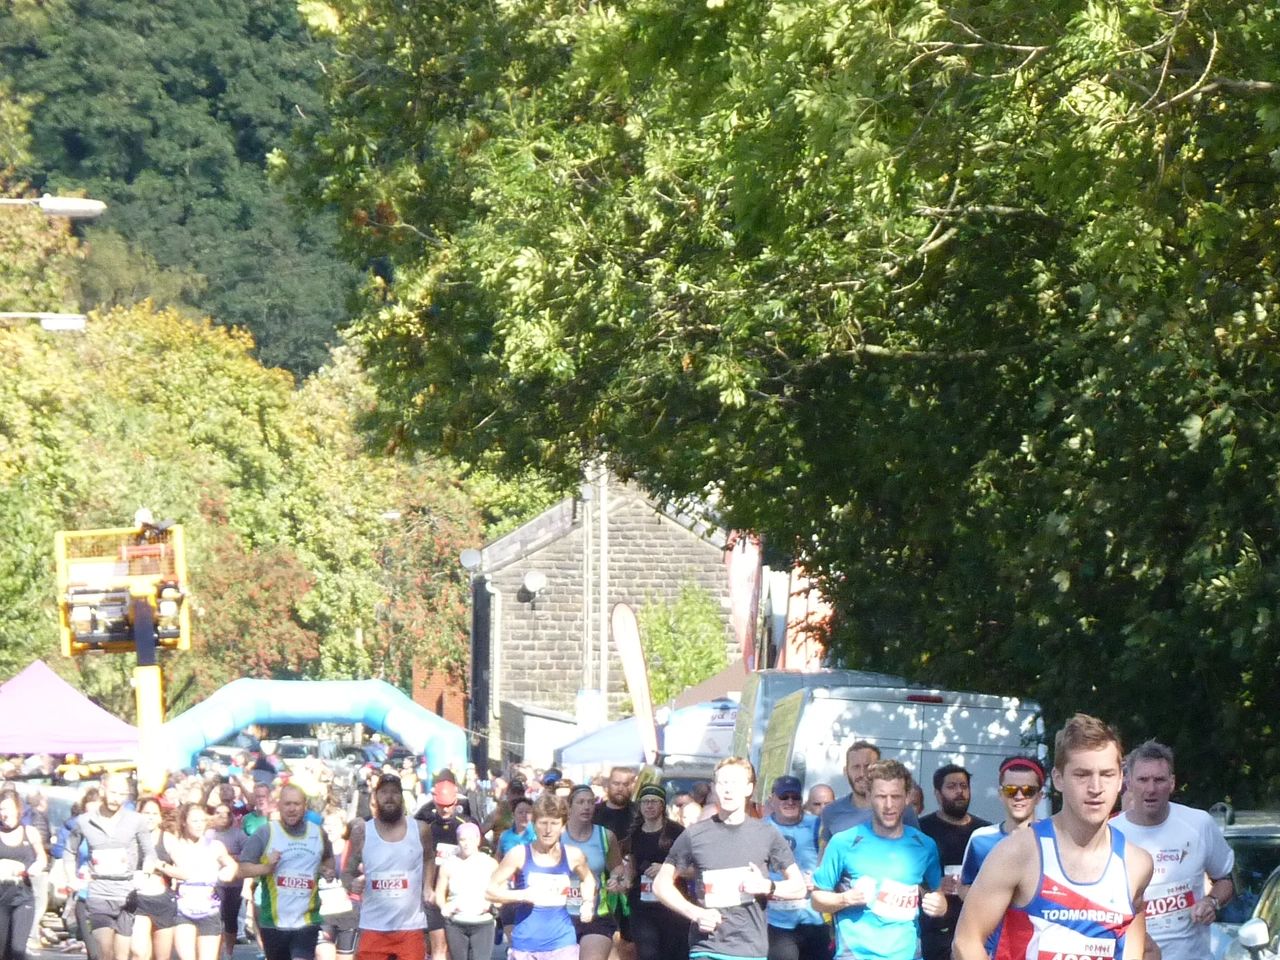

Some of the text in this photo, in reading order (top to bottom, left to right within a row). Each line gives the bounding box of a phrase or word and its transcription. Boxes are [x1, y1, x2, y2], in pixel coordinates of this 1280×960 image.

[281, 877, 309, 888] 4025
[375, 879, 403, 890] 4023
[1145, 893, 1187, 915] 4026
[1041, 909, 1124, 925] TODMORDEN
